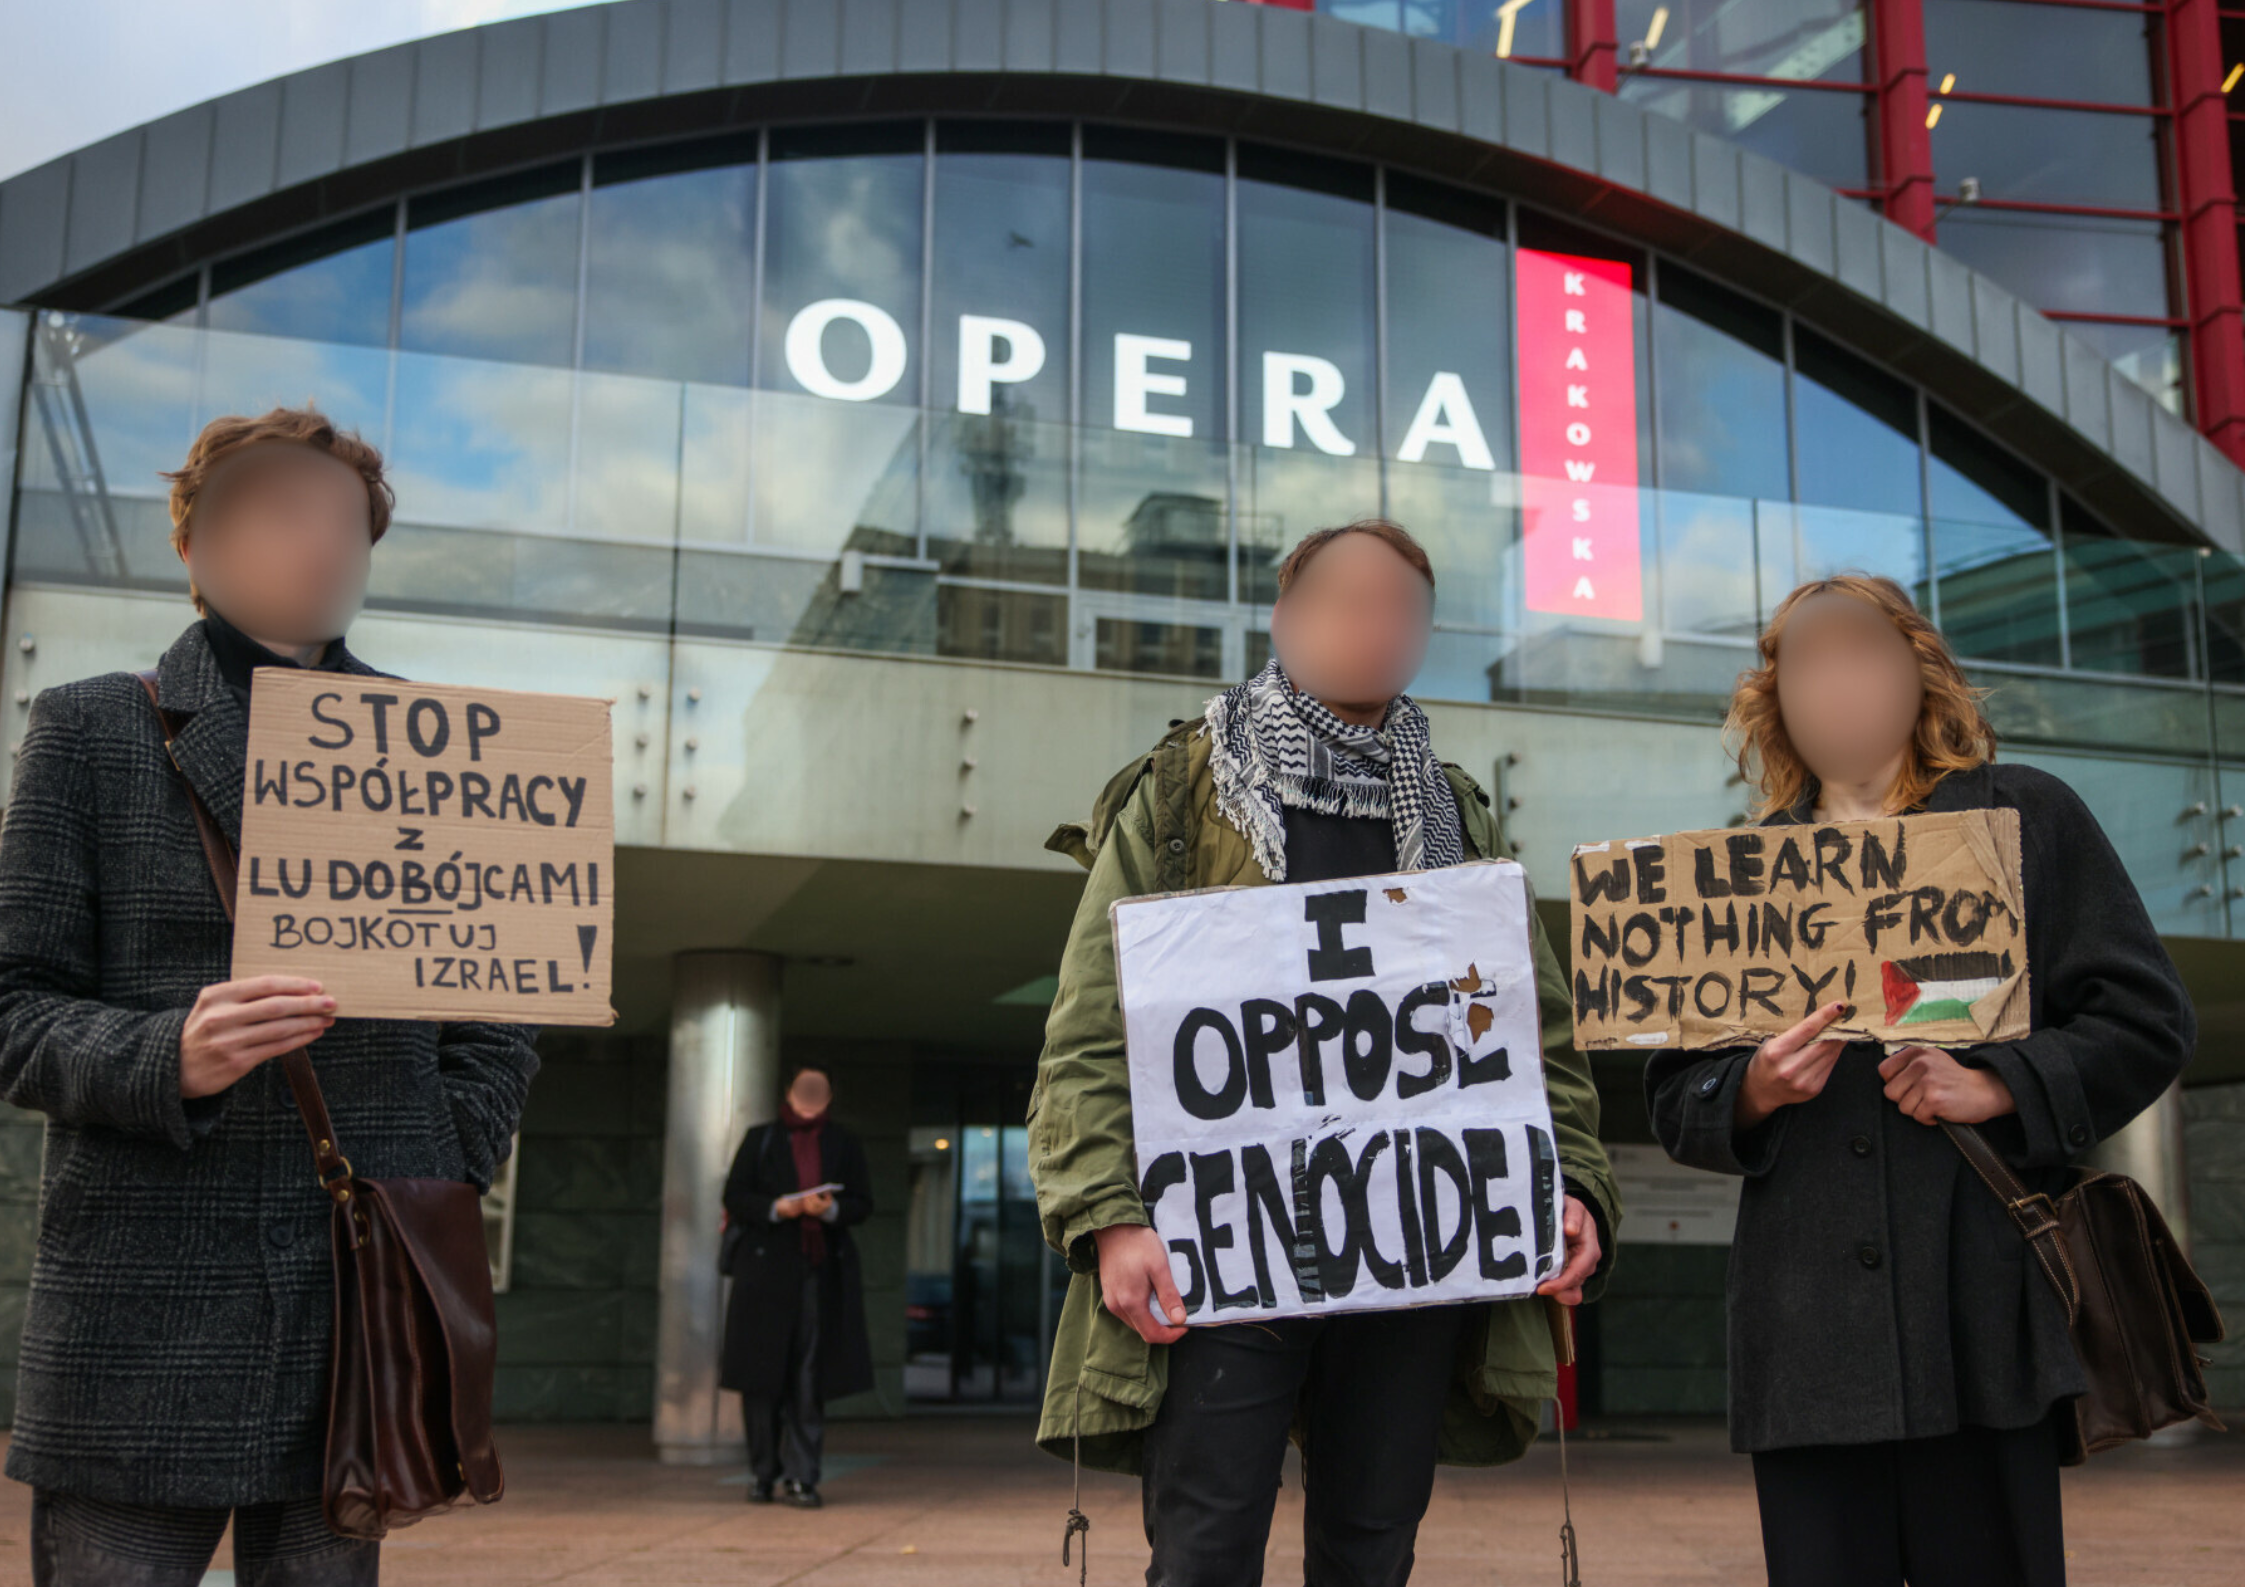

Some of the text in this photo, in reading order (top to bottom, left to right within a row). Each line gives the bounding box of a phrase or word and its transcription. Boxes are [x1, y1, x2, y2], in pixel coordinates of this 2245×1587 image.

[785, 298, 1496, 470] OPERA
[1563, 271, 1596, 600] KRAKOWSKA
[308, 693, 501, 761] STOP
[254, 757, 587, 828] WSPÓŁPRACY
[1574, 820, 1908, 907] WE LEARN
[269, 912, 496, 950] BOJKOTUJ
[415, 924, 598, 994] IZRAEL!
[1304, 888, 1375, 983] I
[1582, 902, 1840, 968] NOTHING
[1575, 958, 1858, 1024] HISTORY!
[1172, 980, 1513, 1121] OPPOSE
[1140, 1123, 1558, 1317] GENOCIDE!
